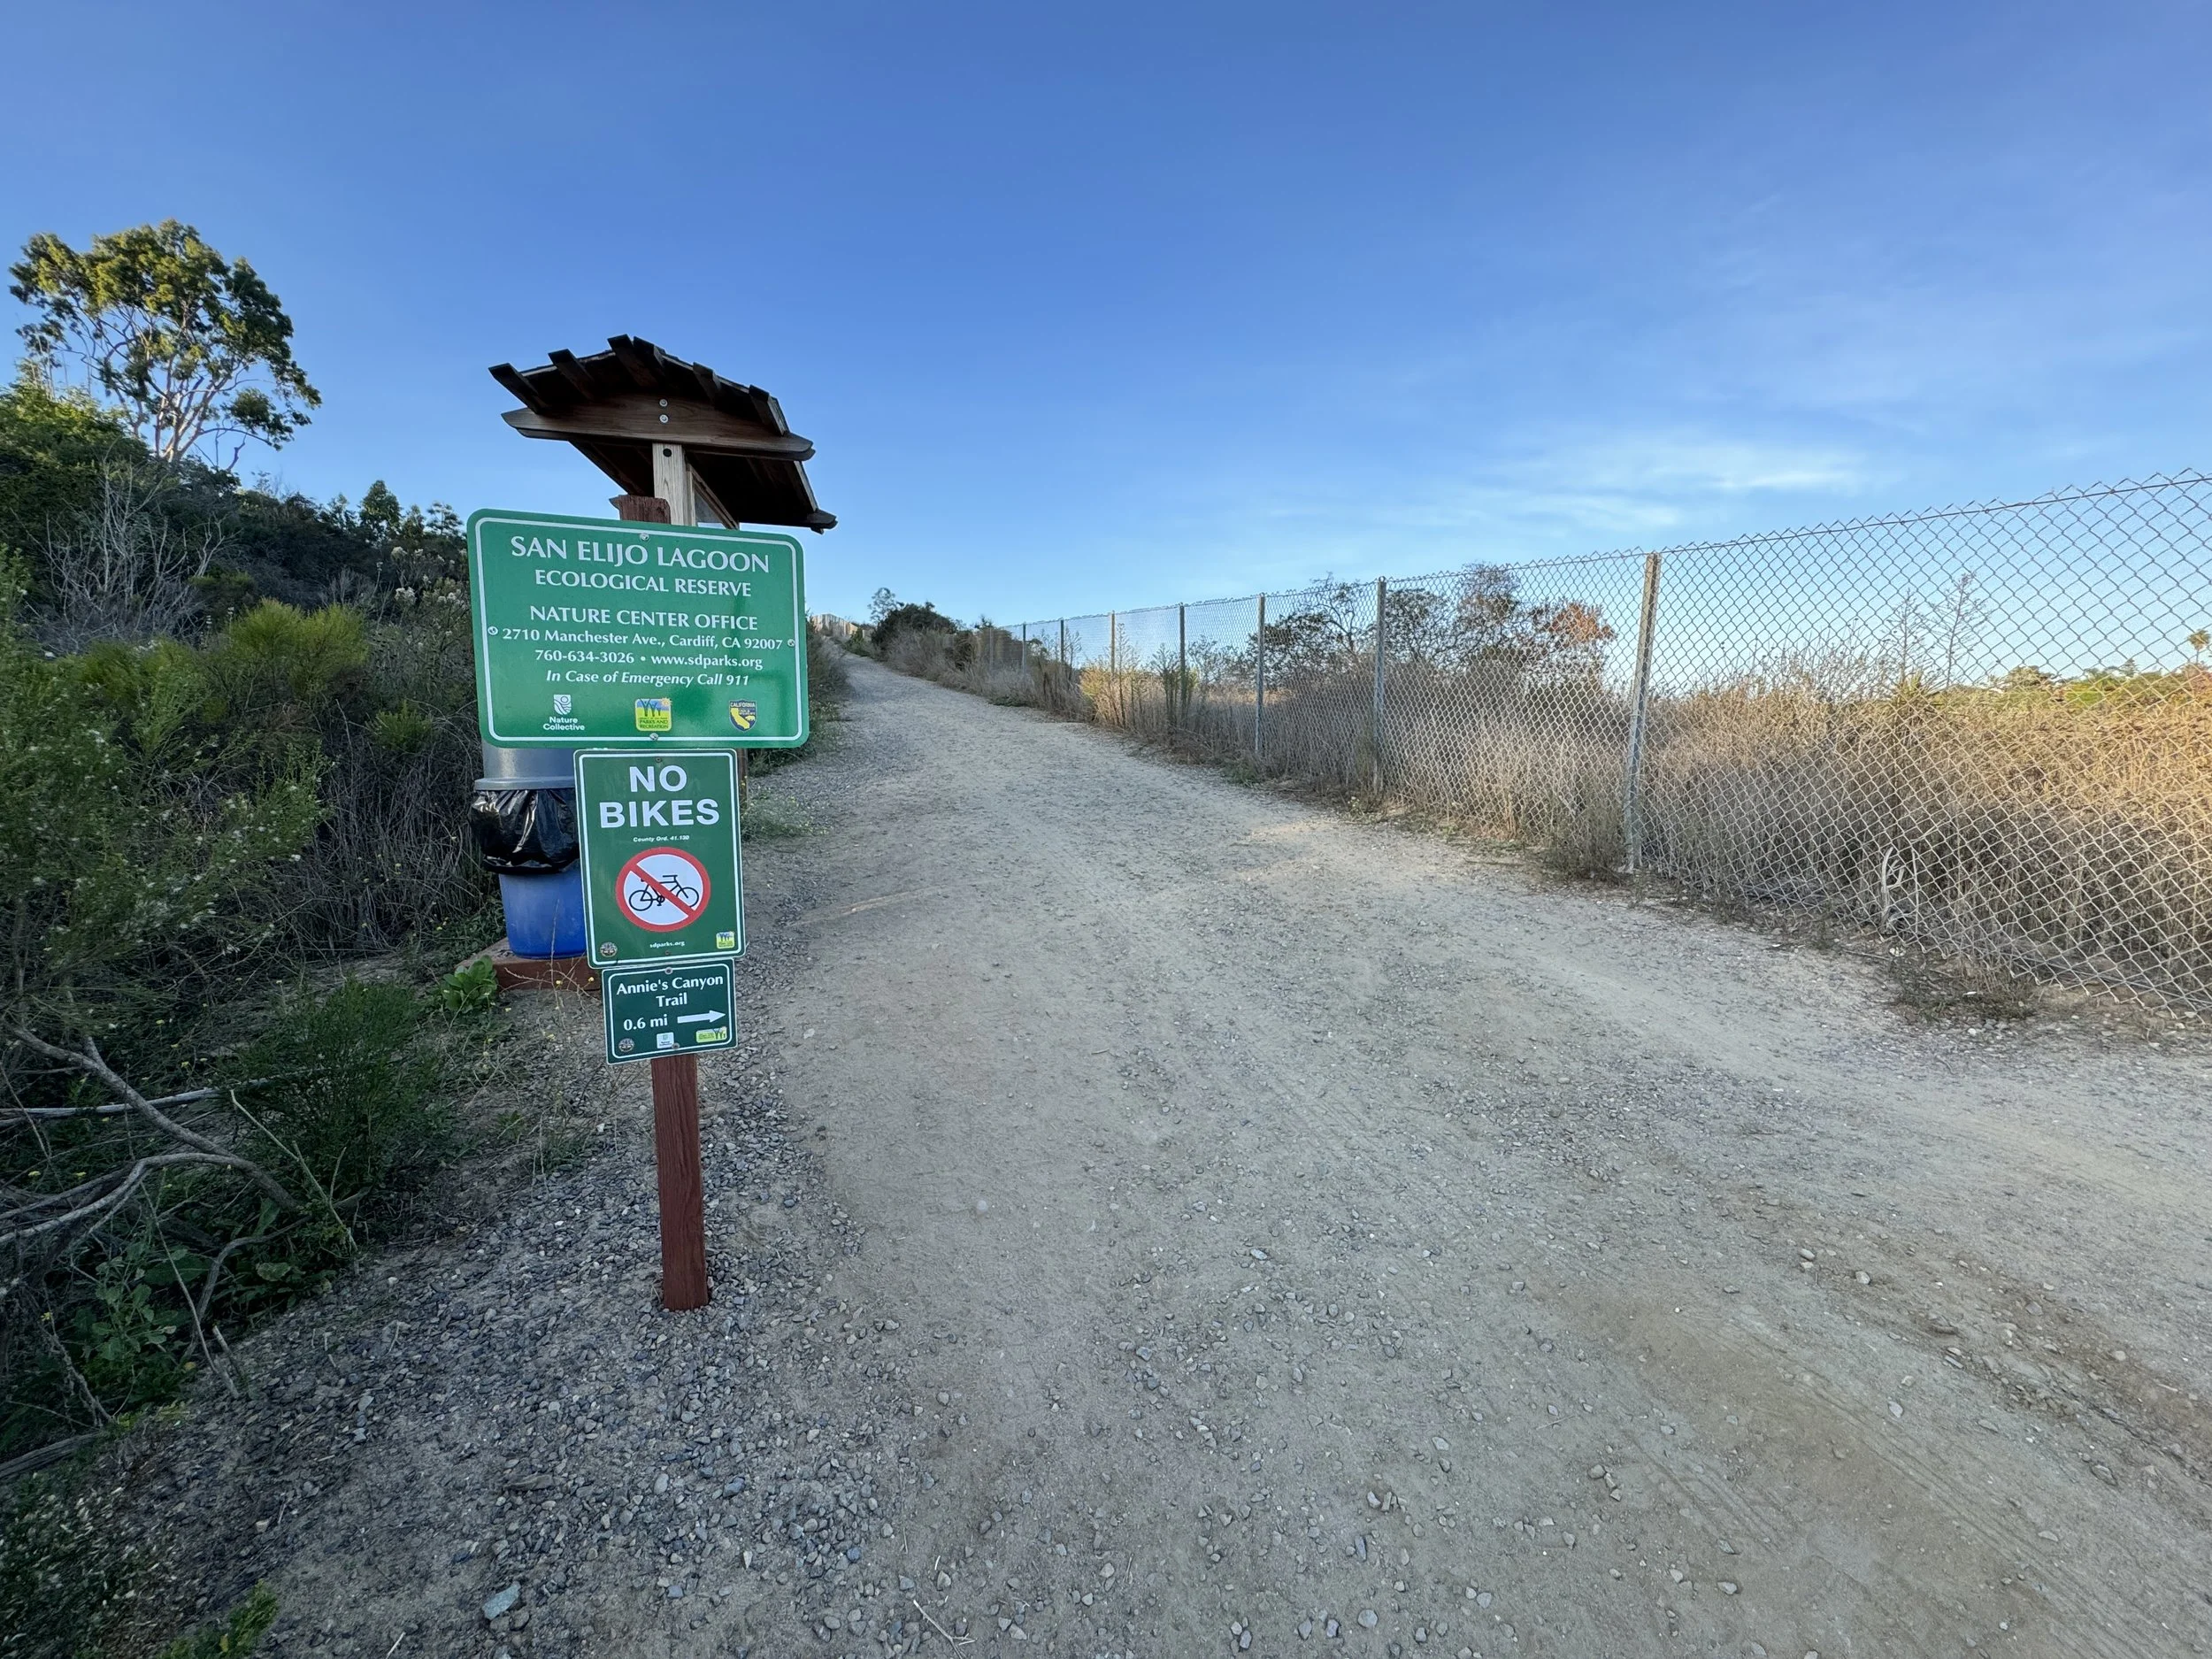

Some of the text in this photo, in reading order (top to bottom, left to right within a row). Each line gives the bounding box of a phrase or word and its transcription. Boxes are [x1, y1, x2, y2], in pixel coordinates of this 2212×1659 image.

[511, 535, 769, 573] SAN ELIJO LAGOON
[535, 569, 751, 597] ECOLOGICAL RESERVE
[530, 605, 758, 631] NATURE CENTER OFFICE
[503, 627, 783, 649] 2710 Manchester Ave., Cardiff, CA 92007
[535, 649, 763, 670] 760-634-3026 www.sdparks.org
[546, 670, 749, 687] In Case of Emergency Call 911
[629, 765, 687, 793] NO
[599, 798, 720, 828] BIKES
[617, 976, 724, 995] Annie's Canyon
[656, 992, 688, 1008] Trail
[623, 1014, 668, 1031] 0.6 mi
